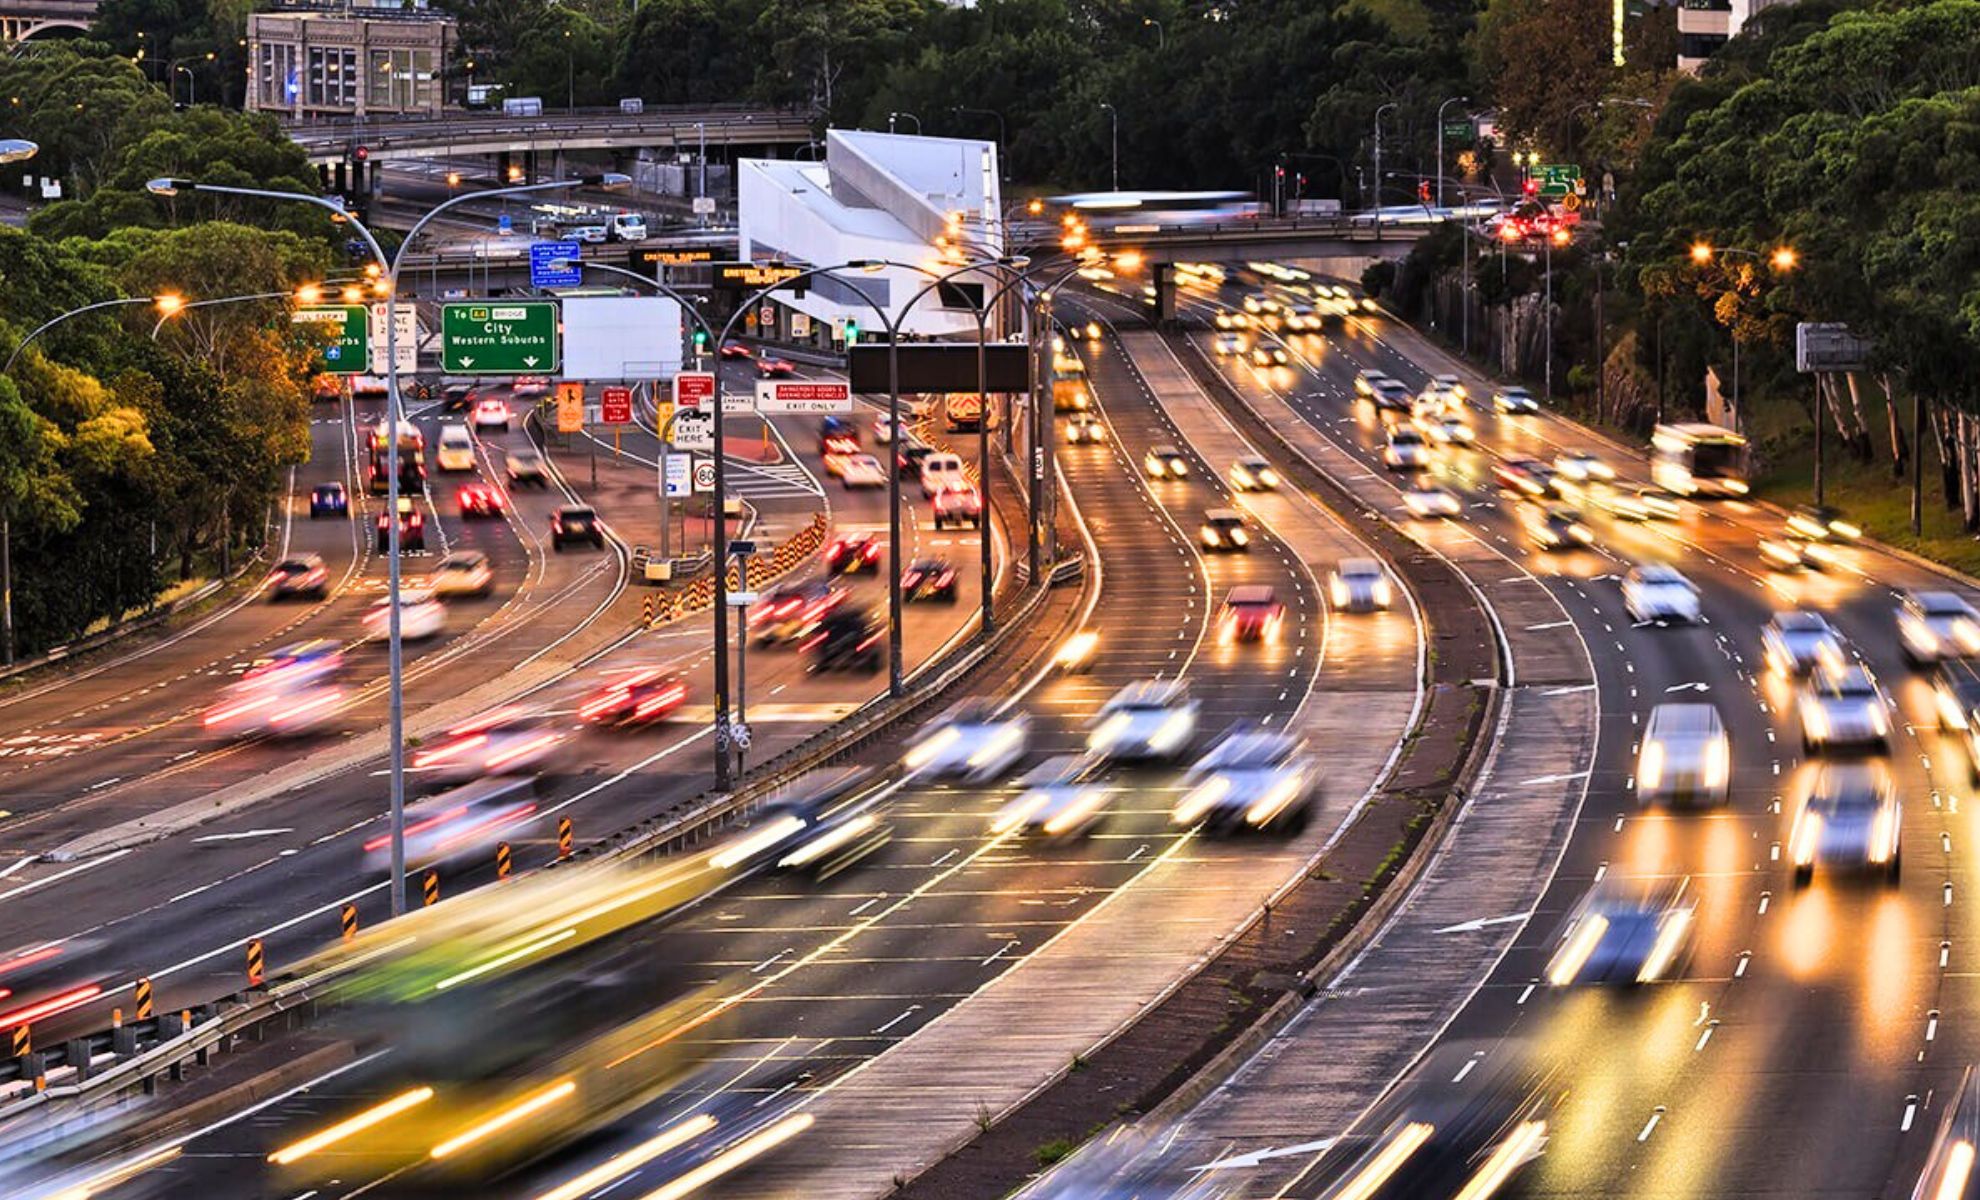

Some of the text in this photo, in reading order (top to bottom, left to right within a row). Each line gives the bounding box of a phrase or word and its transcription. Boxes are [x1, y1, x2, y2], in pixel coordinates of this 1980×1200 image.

[723, 266, 801, 277] EASTERN SUBURBS
[453, 309, 467, 320] To
[494, 310, 524, 318] BRIDGE
[483, 321, 512, 335] City
[451, 335, 546, 345] Western Suburbs
[785, 402, 836, 410] EXIT ONLY
[678, 425, 701, 434] EXIT
[676, 434, 704, 444] HERE
